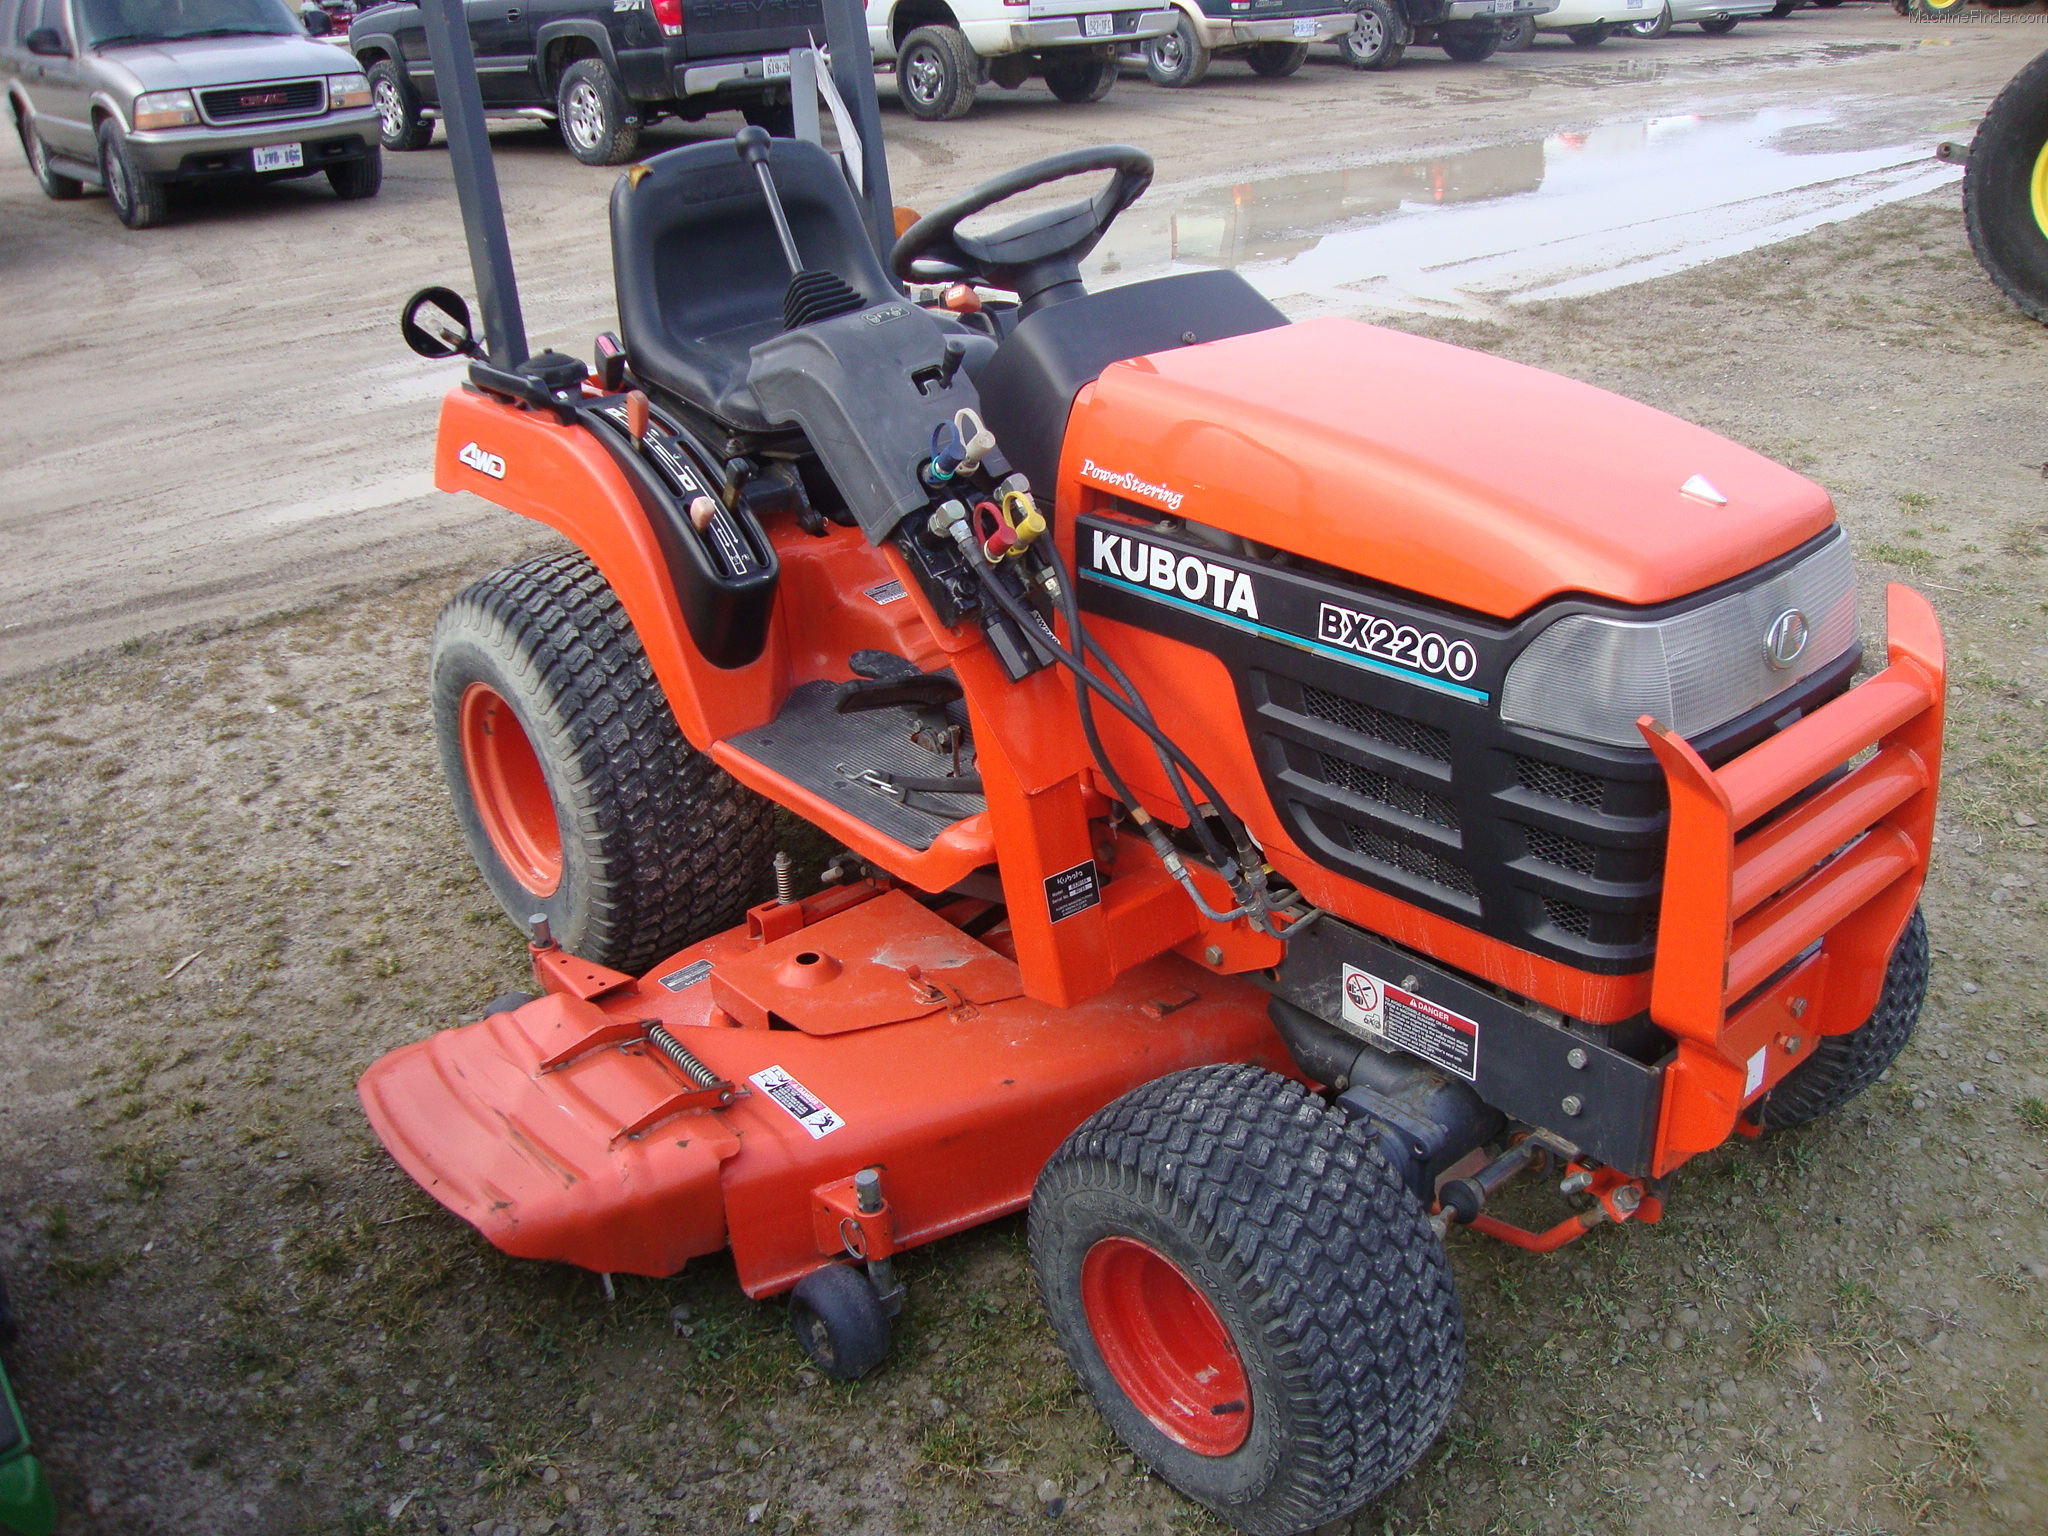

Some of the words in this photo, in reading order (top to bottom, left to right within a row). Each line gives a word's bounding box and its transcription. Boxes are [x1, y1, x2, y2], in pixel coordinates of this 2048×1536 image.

[613, 0, 645, 12] Z71
[459, 441, 506, 480] 4WD
[1080, 459, 1184, 510] PowerSteering
[1093, 530, 1259, 620] KUBOTA
[1318, 602, 1478, 682] BX2200
[1418, 1002, 1450, 1022] DANGER
